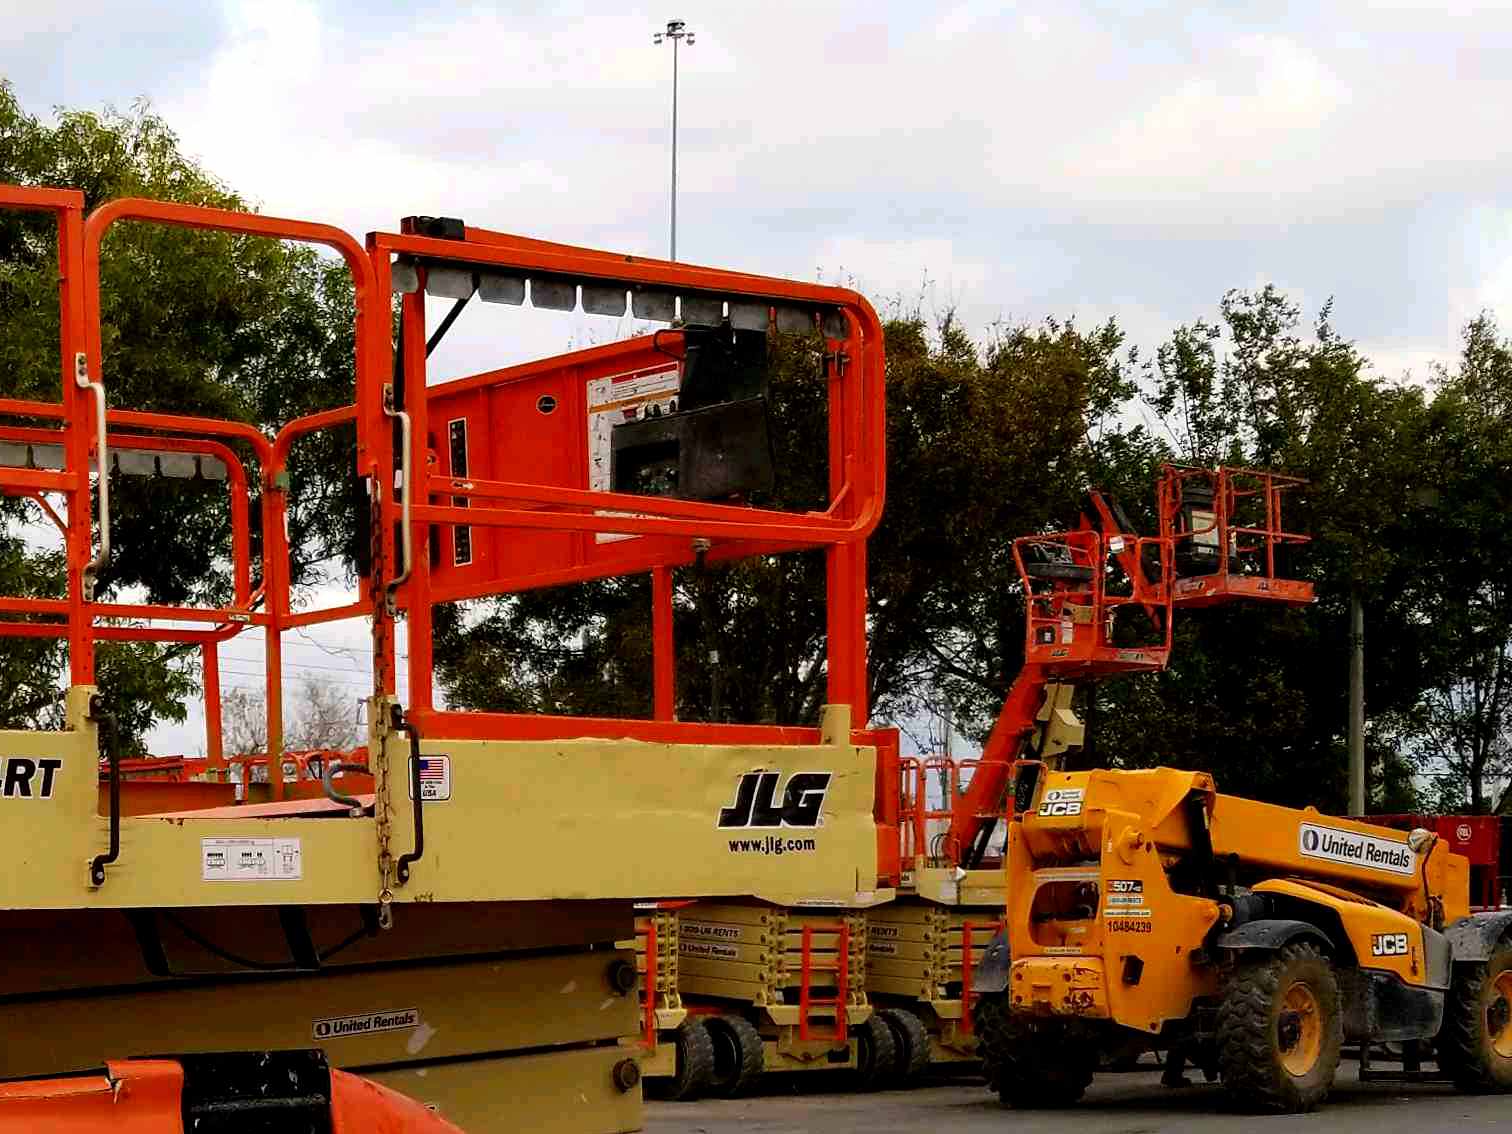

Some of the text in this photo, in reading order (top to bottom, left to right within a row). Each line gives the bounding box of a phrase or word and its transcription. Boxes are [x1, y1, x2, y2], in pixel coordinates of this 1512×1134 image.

[718, 772, 832, 828] JLG
[1040, 801, 1082, 815] JCB
[728, 836, 816, 855] www.jlg.com
[1320, 833, 1411, 868] United Rentals
[1372, 934, 1408, 955] JCB
[333, 1012, 414, 1034] United Rentals
